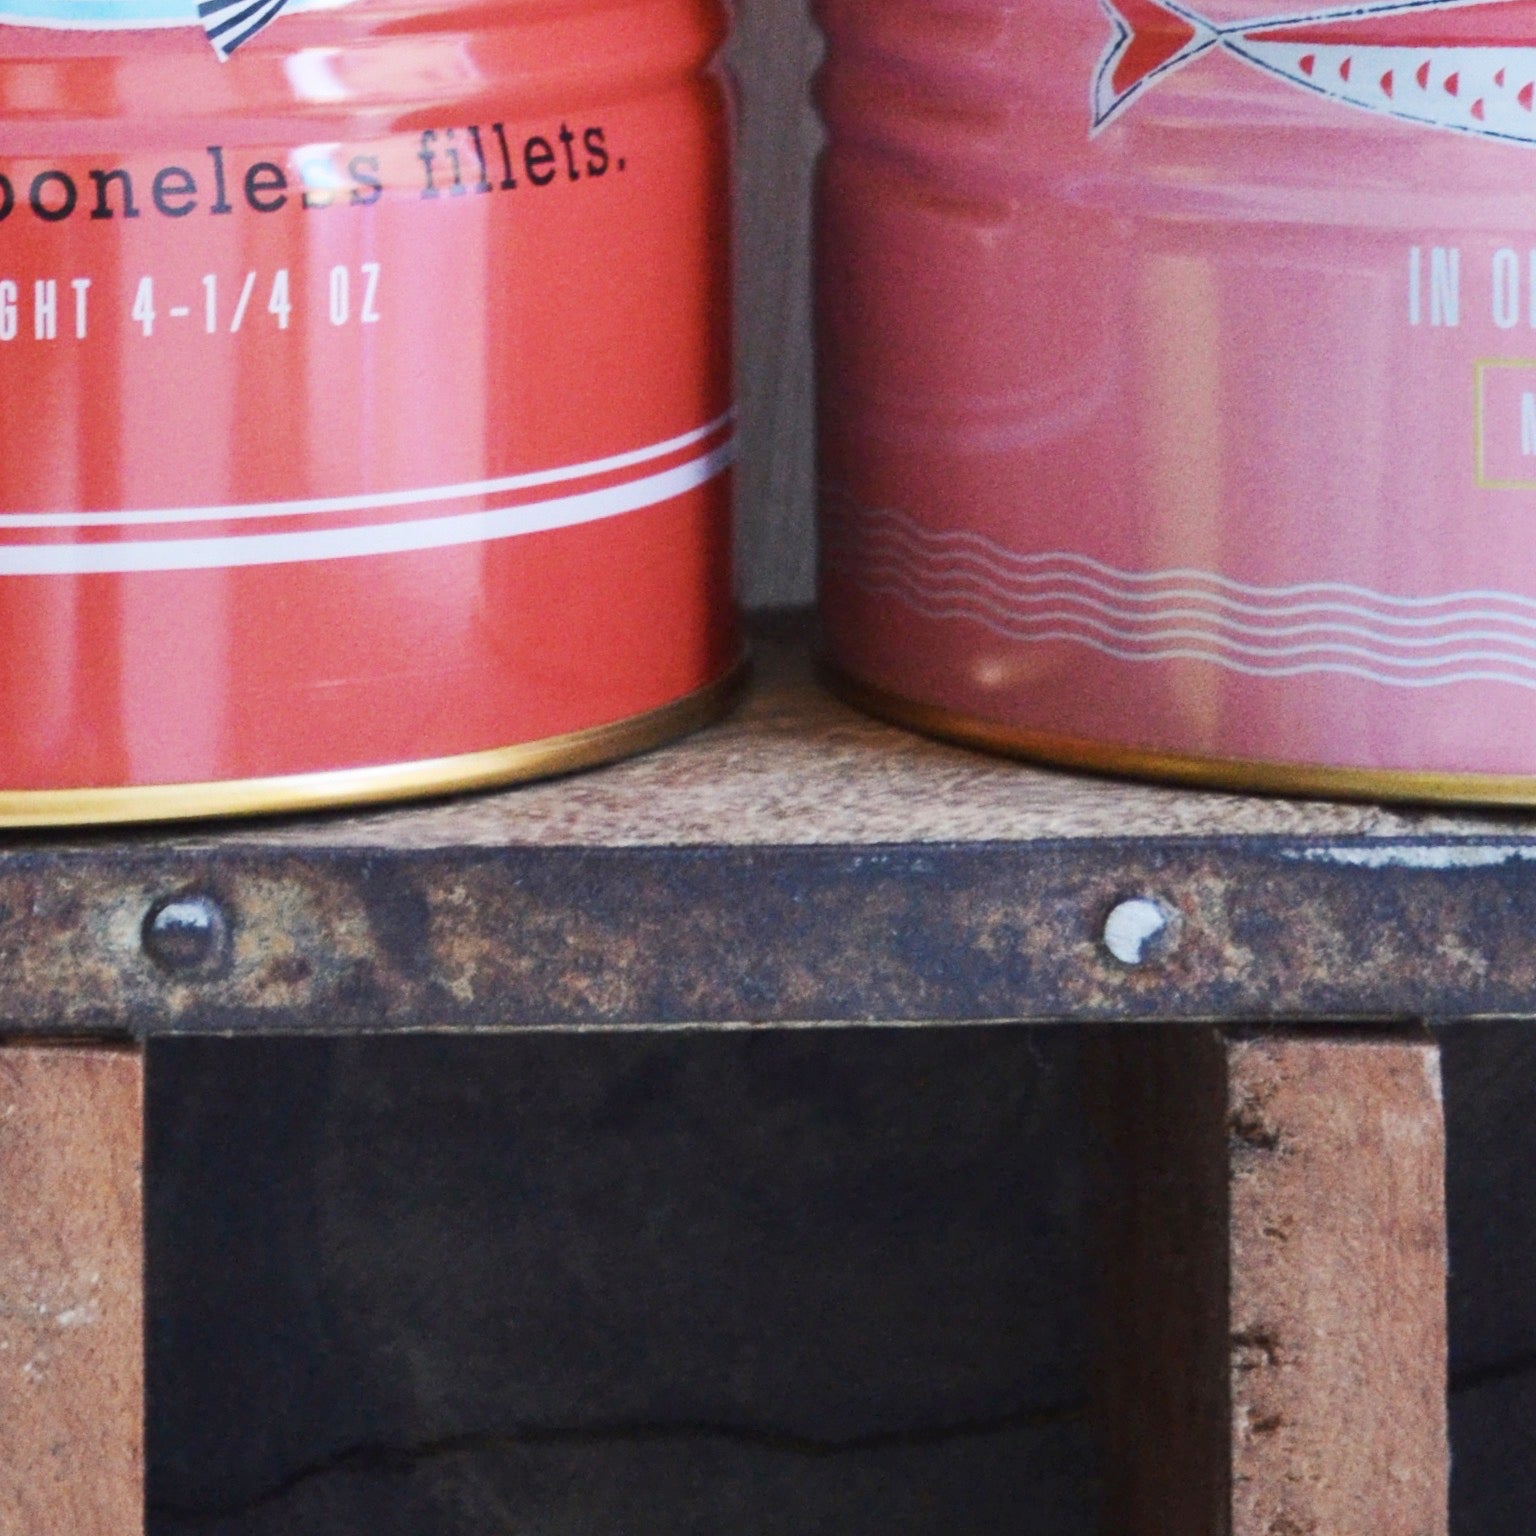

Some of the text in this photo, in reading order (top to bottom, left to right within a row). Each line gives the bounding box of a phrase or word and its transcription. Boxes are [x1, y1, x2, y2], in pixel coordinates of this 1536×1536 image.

[417, 122, 627, 200] fillets.
[132, 269, 291, 336] 4-1/4
[329, 263, 381, 326] OZ
[1409, 245, 1460, 328] IN
